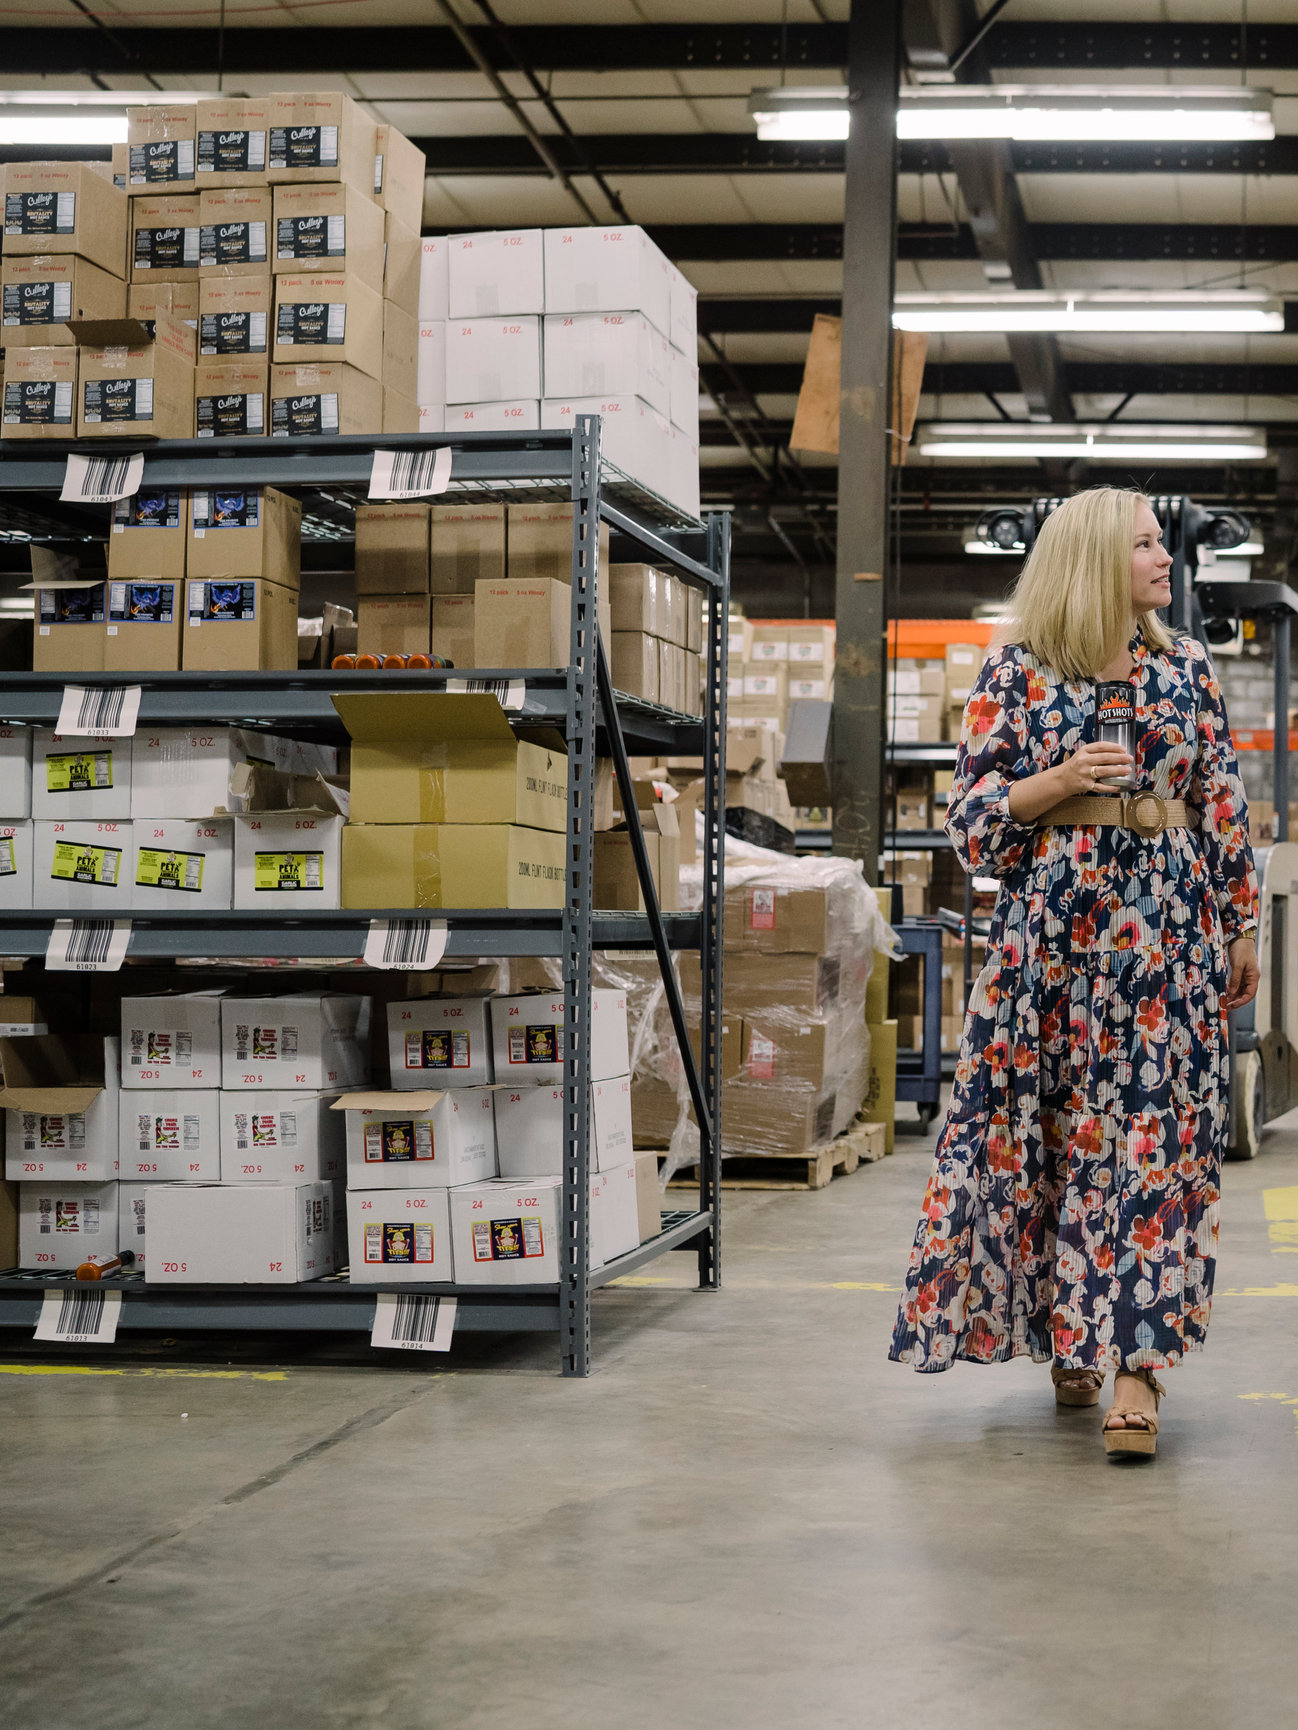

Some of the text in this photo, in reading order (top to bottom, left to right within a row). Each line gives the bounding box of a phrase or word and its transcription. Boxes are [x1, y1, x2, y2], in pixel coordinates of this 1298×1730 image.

[562, 236, 573, 244] 24
[462, 241, 473, 249] 24
[563, 318, 574, 327] 24
[462, 328, 472, 336] 24
[464, 411, 474, 419] 24
[560, 407, 571, 415] 24
[1098, 707, 1134, 720] HOT SHOTS
[148, 737, 216, 747] 24 5 OZ.
[54, 823, 119, 832] 24 5 OZ.
[251, 821, 317, 830] 24 5 OZ.
[153, 829, 218, 837] 24 5 OZ.
[401, 1011, 412, 1019] 24
[508, 1008, 519, 1016] 24
[192, 1069, 203, 1078] 24
[295, 1074, 306, 1083] 24
[510, 1094, 521, 1102] 24
[76, 1163, 87, 1171] 24
[189, 1163, 200, 1172] 24
[294, 1164, 305, 1173] 24
[361, 1201, 372, 1209] 24
[406, 1200, 411, 1208] 5
[471, 1200, 483, 1209] 24
[516, 1199, 522, 1207] 5
[161, 1261, 282, 1273] 24 5 OZ.
